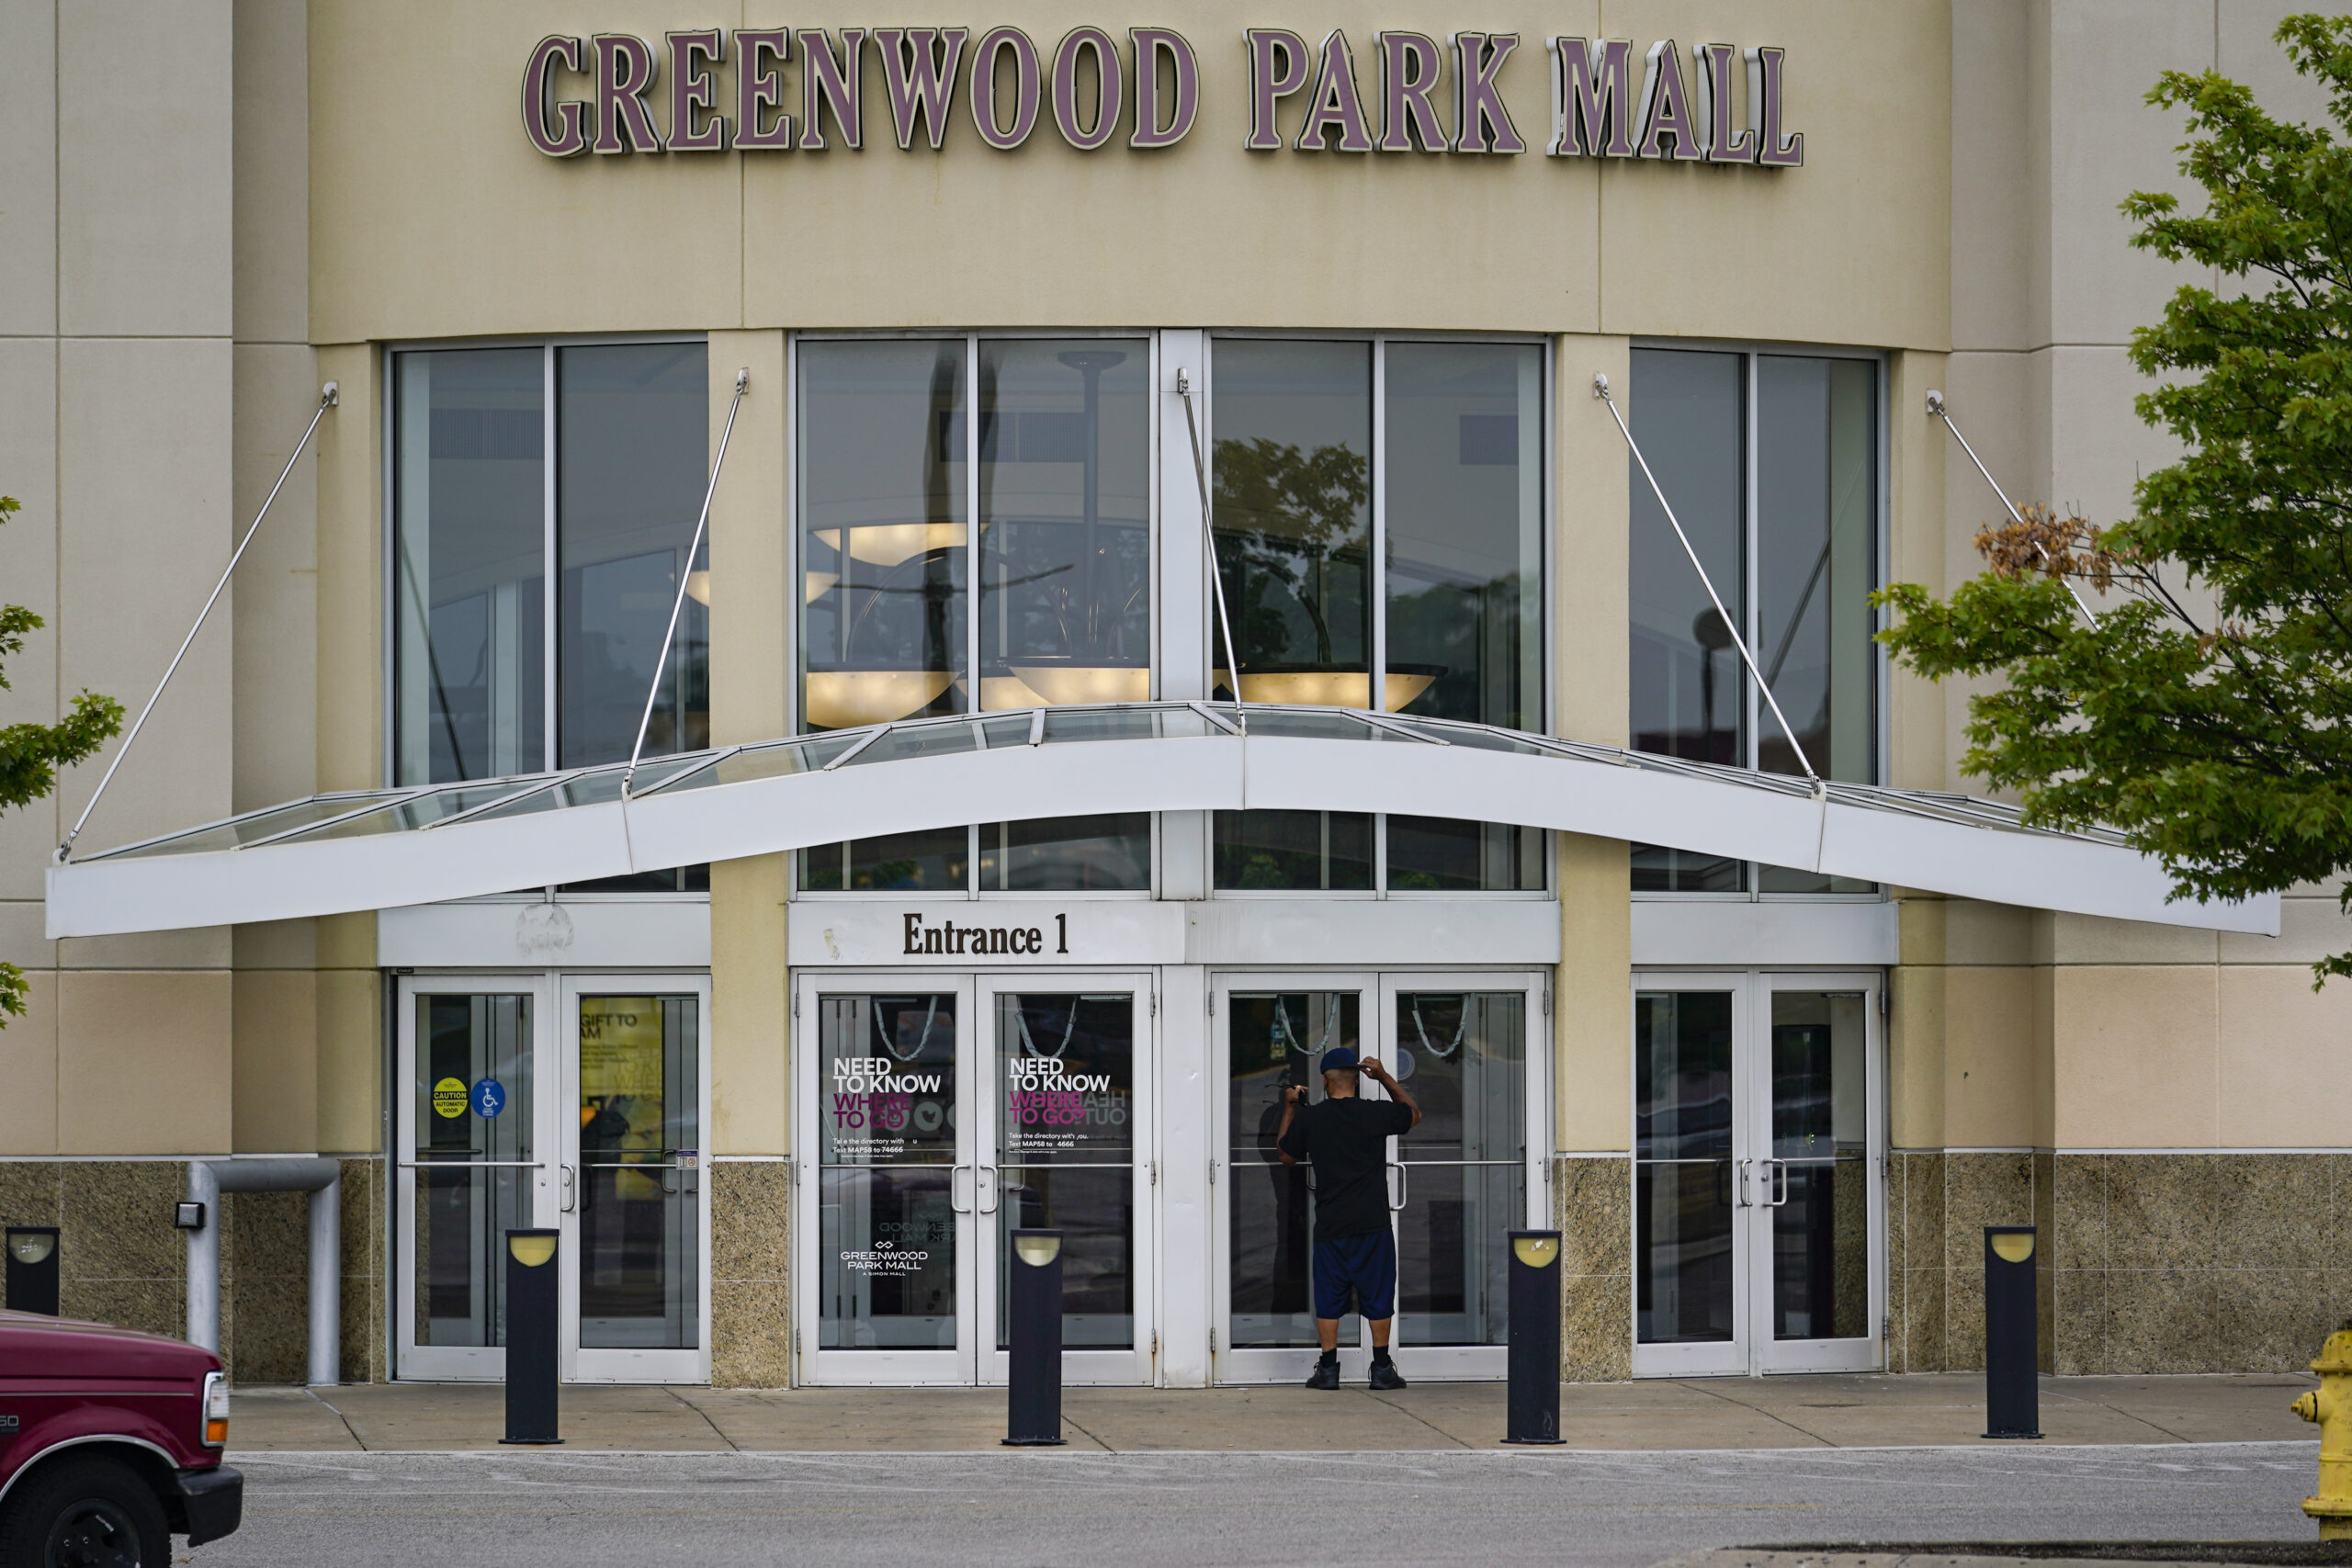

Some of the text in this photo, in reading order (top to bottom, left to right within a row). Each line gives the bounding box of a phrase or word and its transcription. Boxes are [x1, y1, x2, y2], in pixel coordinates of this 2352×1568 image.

[520, 26, 1804, 168] GREENWOOD PARK MALL
[903, 913, 1069, 954] Entrance 1
[616, 1013, 638, 1027] TO
[834, 1057, 892, 1076] NEED
[1011, 1057, 1064, 1075] NEED
[832, 1075, 941, 1093] TO KNOW
[1009, 1075, 1111, 1092] TO KNOW
[833, 1093, 912, 1111] WHERE
[1009, 1091, 1083, 1108] WHERE
[833, 1111, 904, 1129] TO GO
[1009, 1108, 1085, 1124] TO GO?
[860, 1137, 889, 1145] directory
[840, 1251, 929, 1260] GREENWOOD
[847, 1261, 922, 1269] PARK MALL
